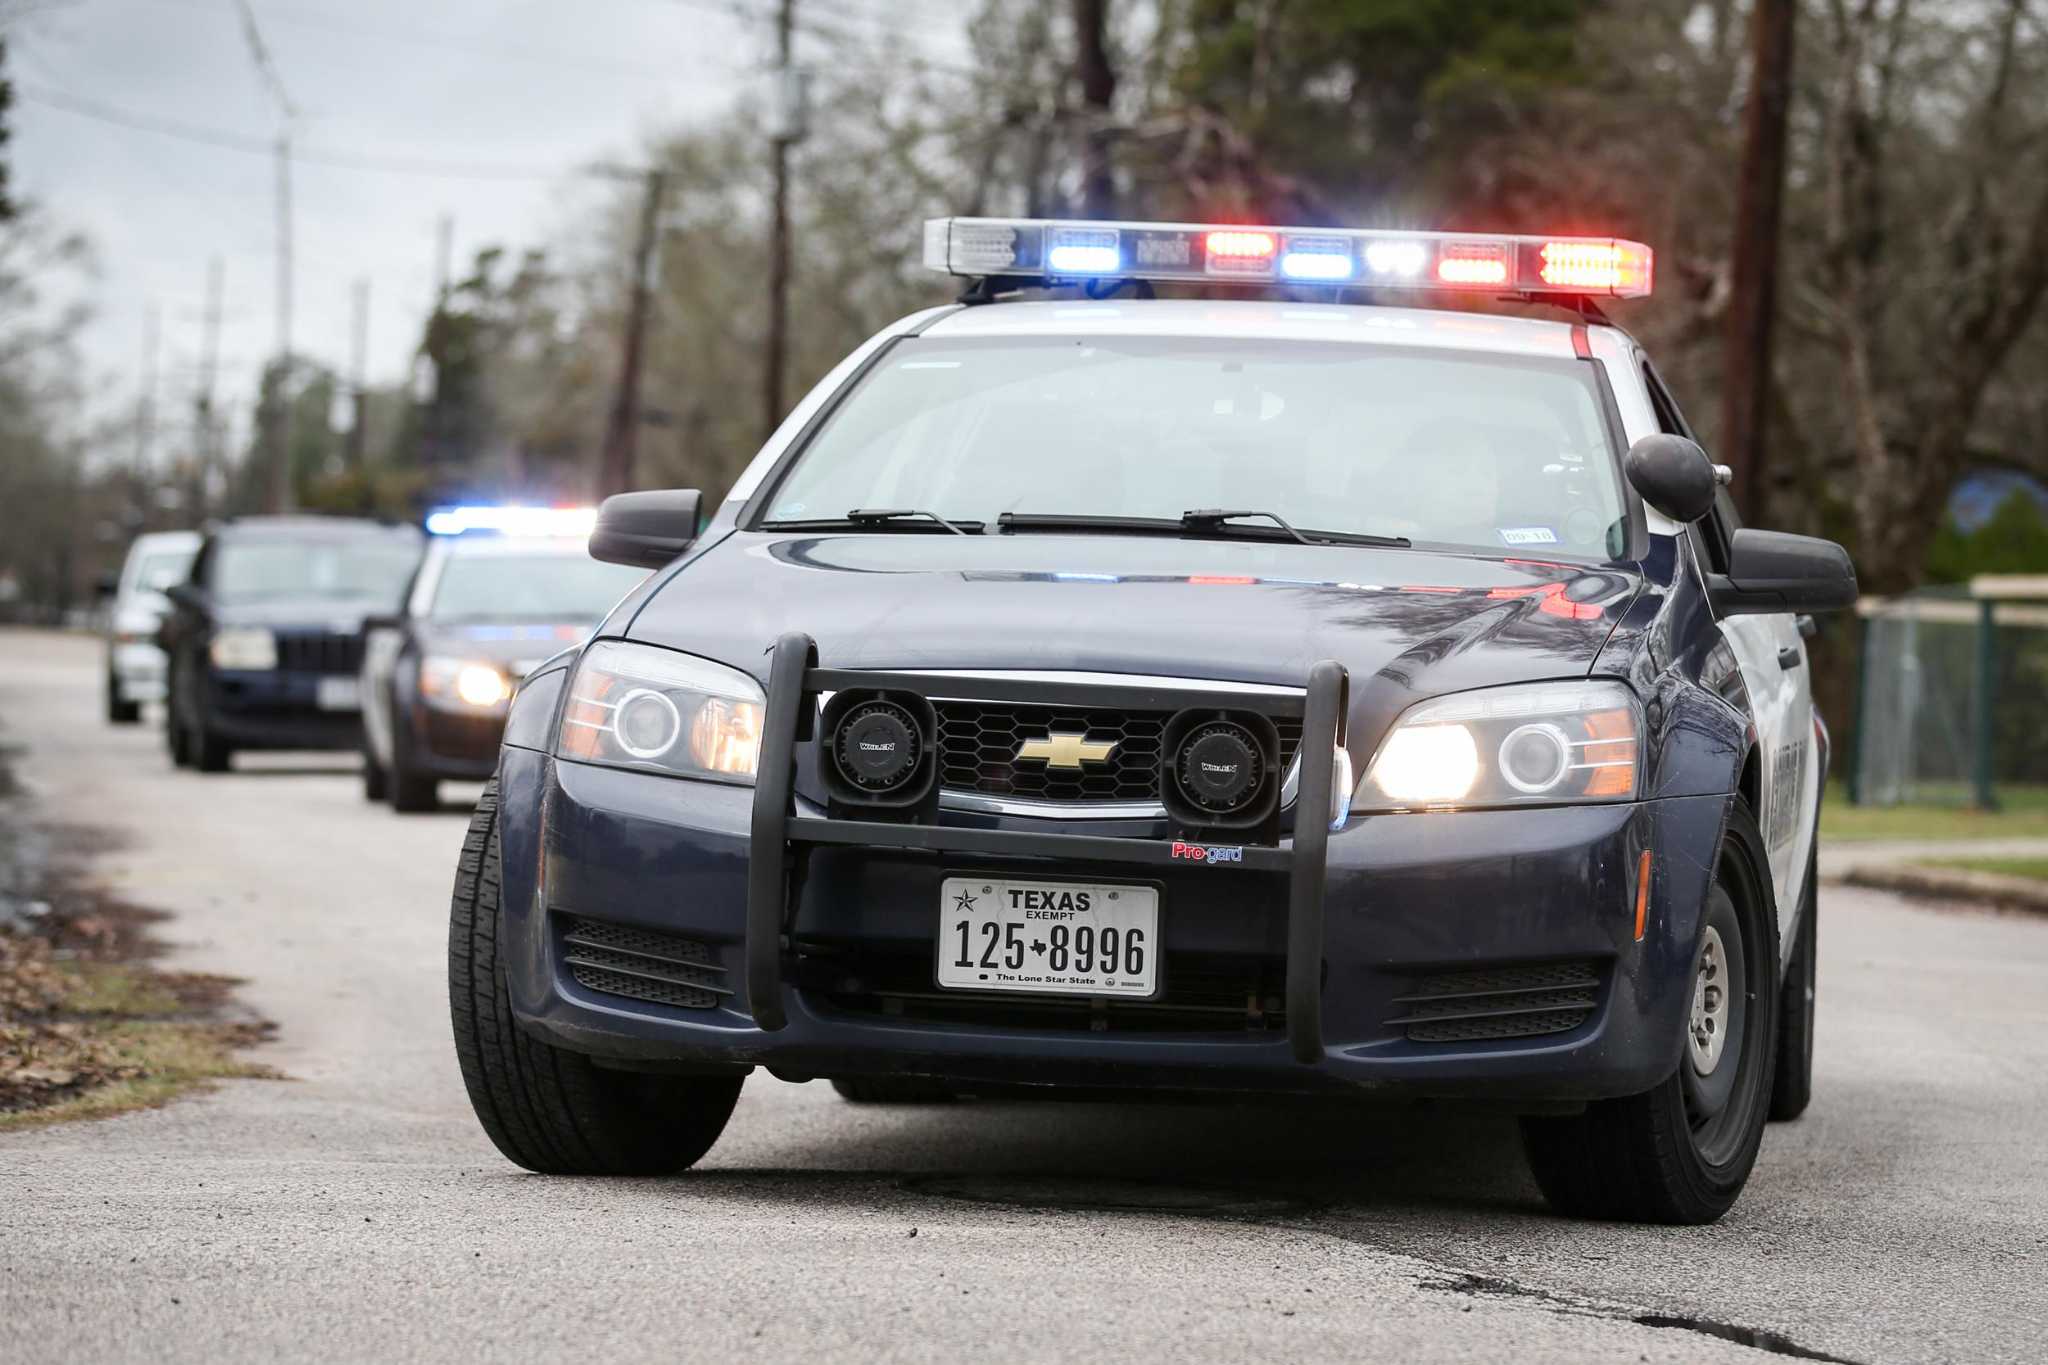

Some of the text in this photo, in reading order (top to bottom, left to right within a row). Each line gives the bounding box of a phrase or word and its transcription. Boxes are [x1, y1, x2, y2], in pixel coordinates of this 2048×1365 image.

[1007, 889, 1091, 912] TEXAS
[1025, 910, 1076, 921] EXEMPT
[954, 920, 1145, 975] 125 8996
[996, 973, 1097, 986] The Lone Star State
